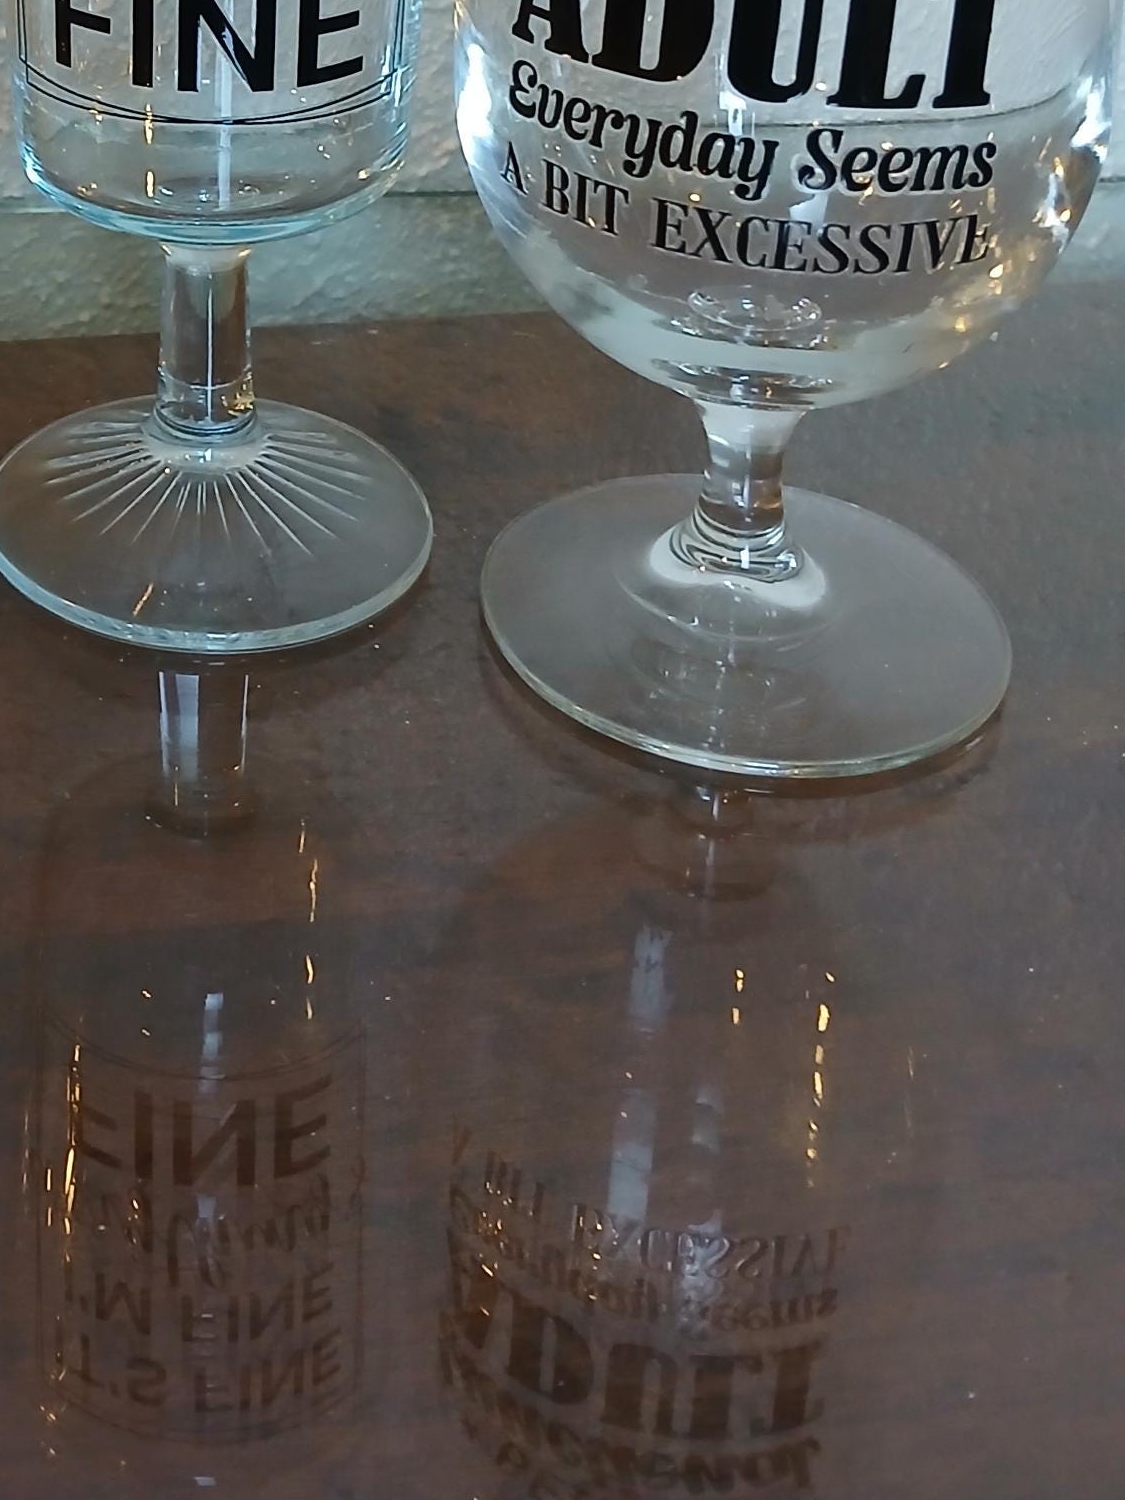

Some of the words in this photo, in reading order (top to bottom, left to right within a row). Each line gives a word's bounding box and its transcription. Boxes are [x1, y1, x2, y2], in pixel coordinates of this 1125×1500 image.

[509, 59, 780, 201] Everyday
[798, 127, 997, 194] Seems
[500, 140, 529, 196] A
[540, 158, 629, 237] BIT
[651, 196, 990, 276] EXCESSIVE
